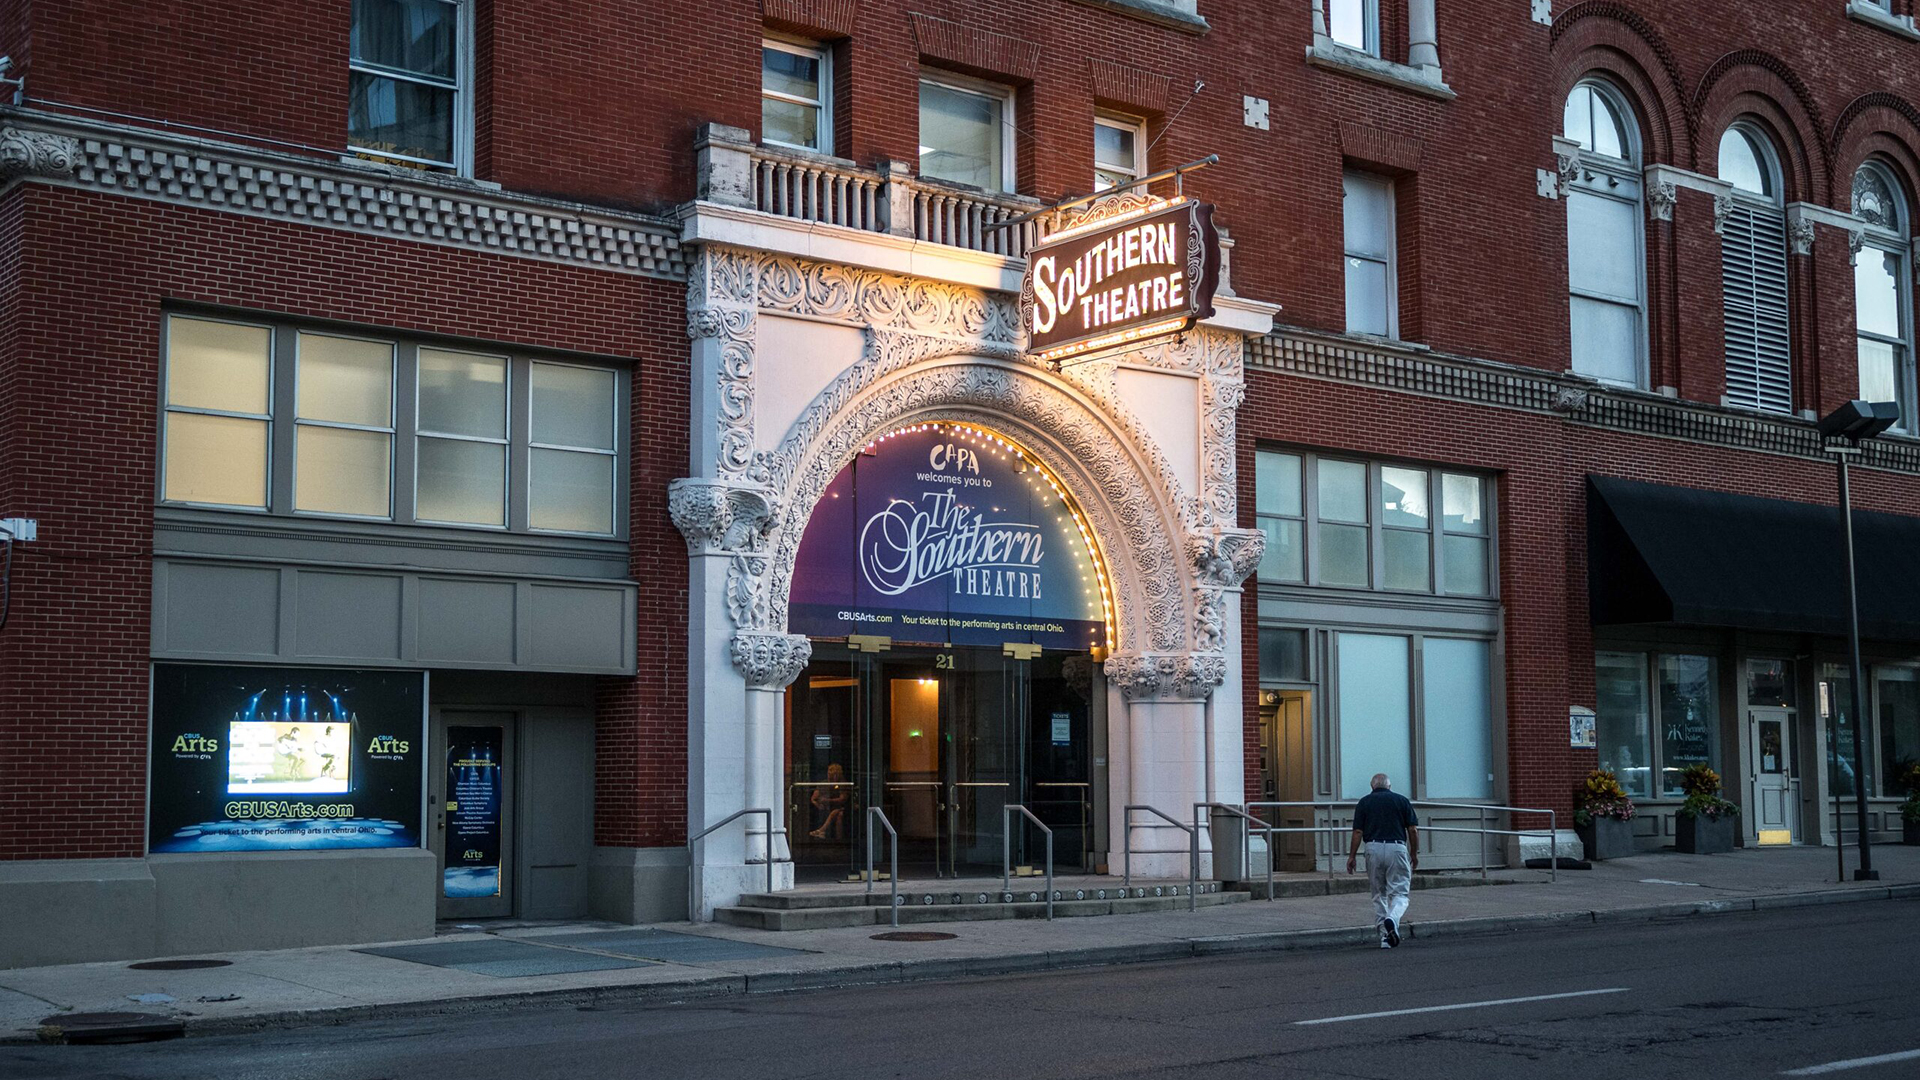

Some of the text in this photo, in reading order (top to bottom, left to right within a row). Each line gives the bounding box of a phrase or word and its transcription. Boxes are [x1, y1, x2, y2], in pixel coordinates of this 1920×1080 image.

[1032, 222, 1176, 334] SOUTHERN
[1080, 271, 1183, 329] THEATRE
[930, 444, 980, 476] CAPA
[916, 471, 992, 488] welcomes you to
[922, 488, 970, 540] The
[860, 499, 1045, 596] Southern
[953, 567, 1042, 599] THEATRE
[838, 610, 1064, 633] CBUSArts.com Your ticket to the performing arts in central Ohio.
[936, 653, 955, 670] 21
[172, 735, 218, 752] Arts
[367, 737, 409, 753] Arts
[225, 800, 354, 818] CBUSArts.com
[265, 828, 306, 836] performing
[463, 850, 483, 859] Arts
